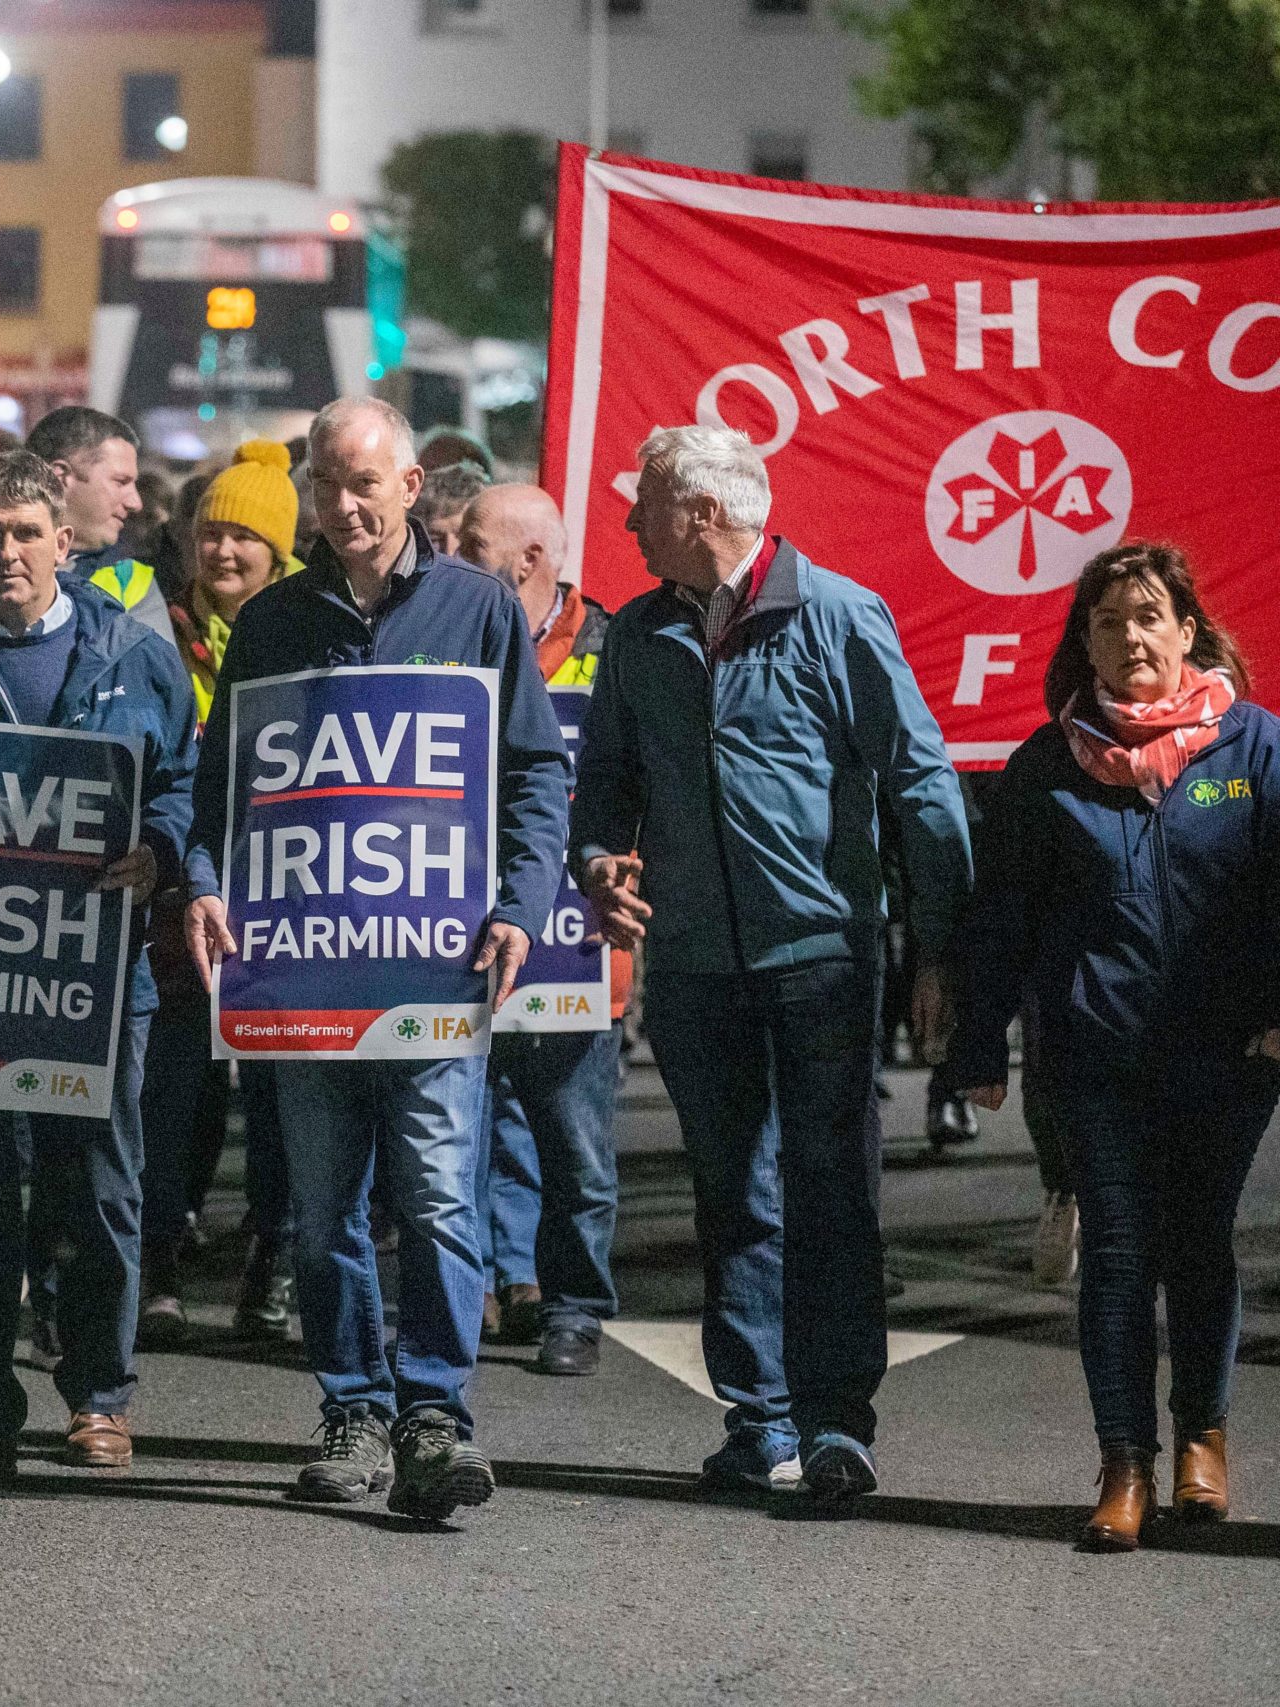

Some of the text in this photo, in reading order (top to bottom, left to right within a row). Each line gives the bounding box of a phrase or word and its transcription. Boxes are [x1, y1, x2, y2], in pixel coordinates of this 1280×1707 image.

[612, 278, 1041, 505] ORTH
[251, 712, 466, 792] SAVE
[1227, 779, 1252, 798] IFA
[248, 822, 466, 901] IRISH
[242, 915, 467, 961] FARMING
[556, 995, 591, 1015] IFA
[234, 1023, 354, 1038] #SaveIrishFarming
[433, 1017, 472, 1040] IFA
[50, 1073, 90, 1099] IFA
